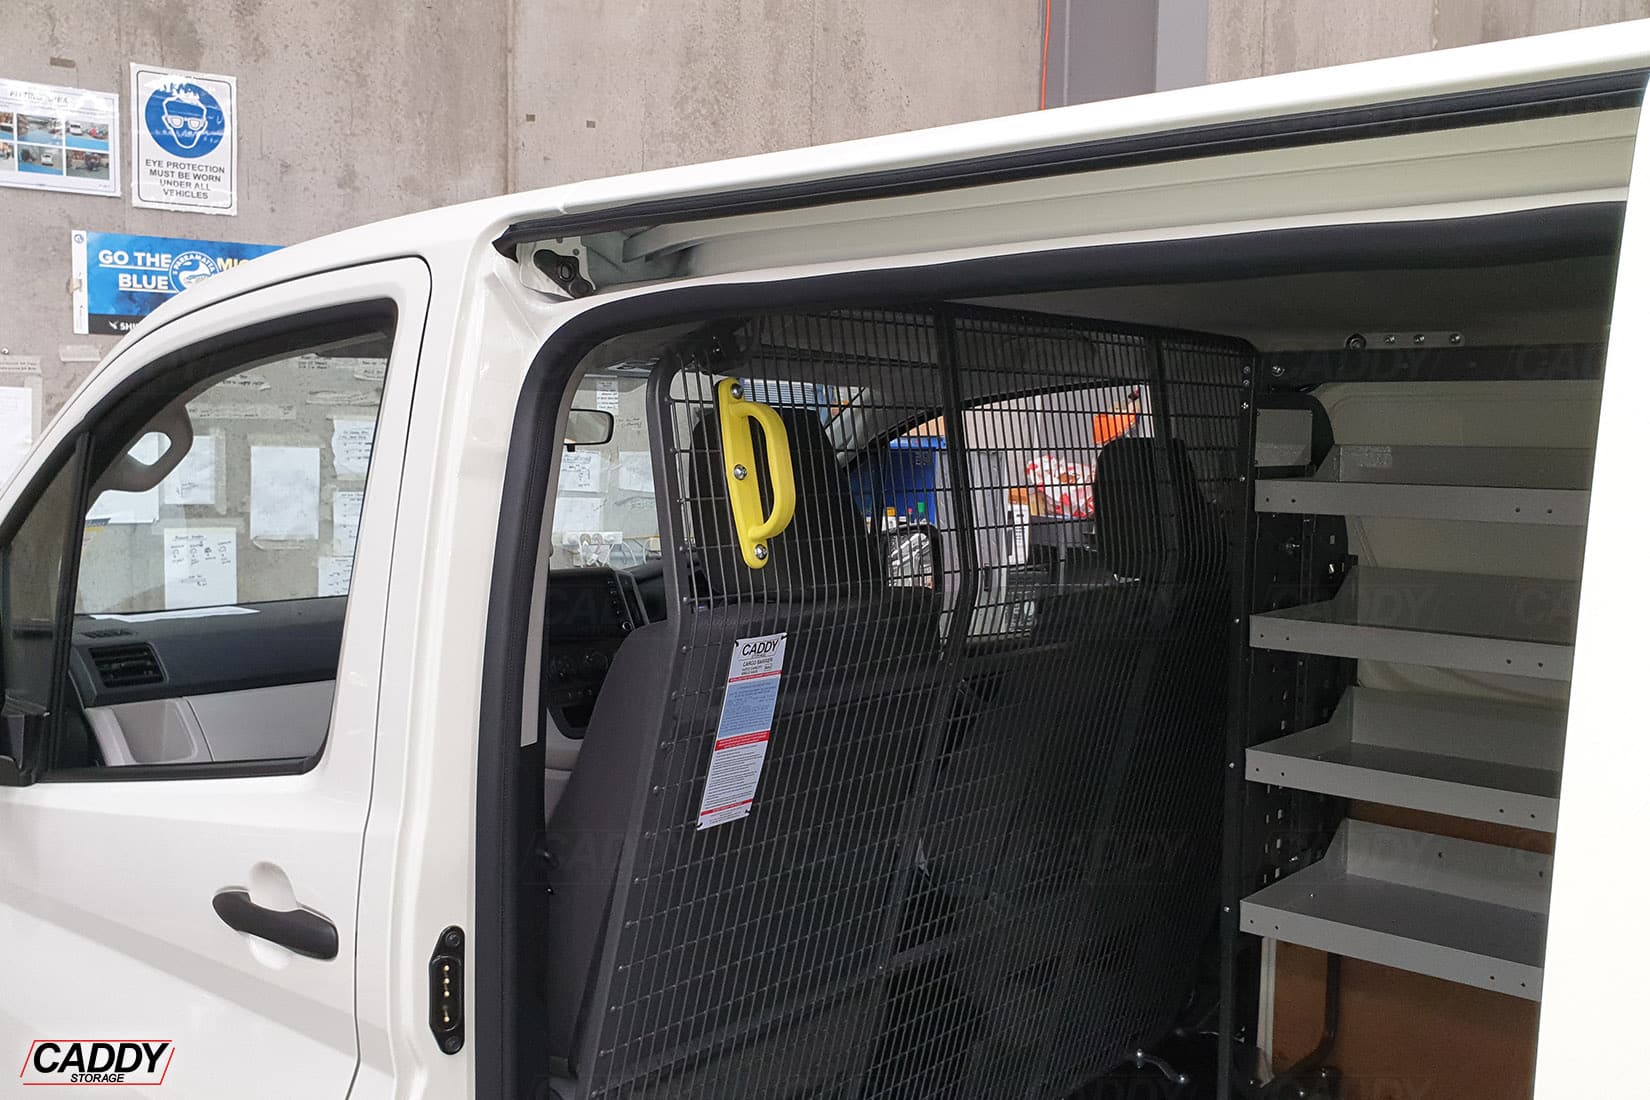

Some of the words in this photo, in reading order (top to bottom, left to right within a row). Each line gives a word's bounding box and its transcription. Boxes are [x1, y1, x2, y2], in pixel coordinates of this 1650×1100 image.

[145, 159, 164, 168] EYE
[166, 161, 225, 174] PROTECTION
[149, 169, 175, 178] MUST
[178, 172, 190, 180] BE
[192, 173, 222, 182] WORN
[160, 179, 192, 189] UNDER
[194, 182, 211, 191] ALL
[163, 188, 209, 200] VEHICLES
[98, 250, 129, 265] GO
[134, 252, 172, 269] THE
[118, 274, 169, 290] BLUE
[742, 639, 779, 656] CADDY
